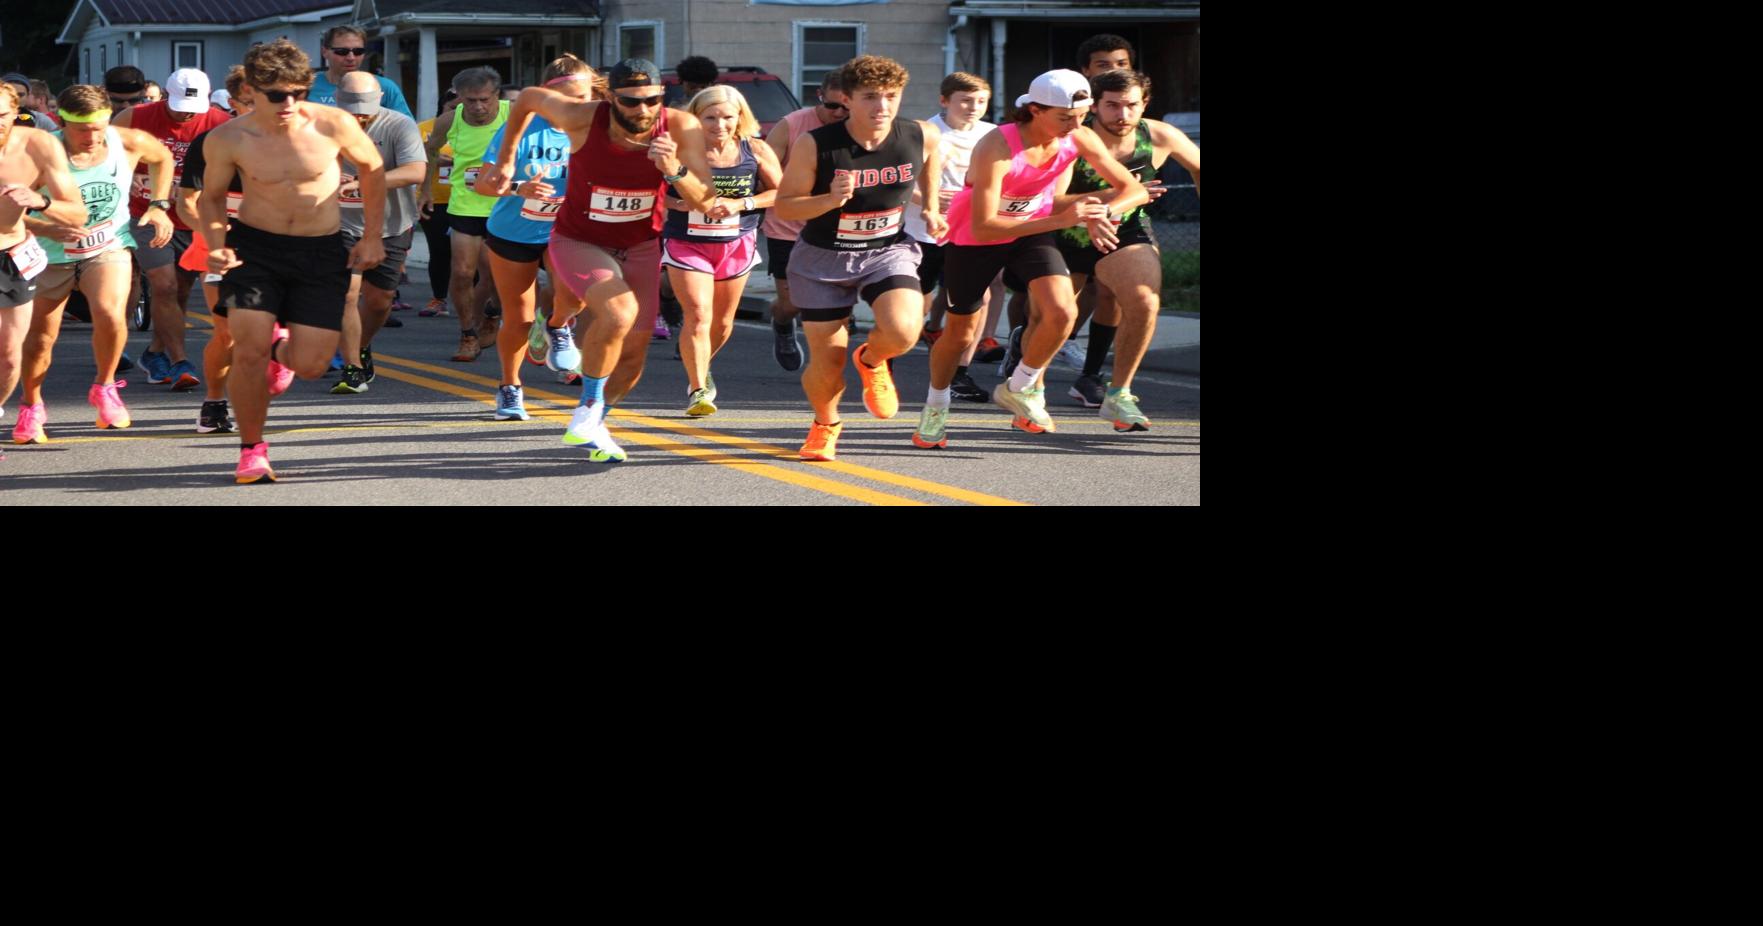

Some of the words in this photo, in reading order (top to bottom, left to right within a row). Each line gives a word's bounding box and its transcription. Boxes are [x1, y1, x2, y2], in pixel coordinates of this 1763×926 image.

[91, 182, 117, 198] DEEP
[540, 202, 561, 212] 77
[604, 196, 642, 212] 148
[1006, 201, 1030, 212] 52
[853, 217, 889, 231] 163
[76, 230, 105, 249] 100
